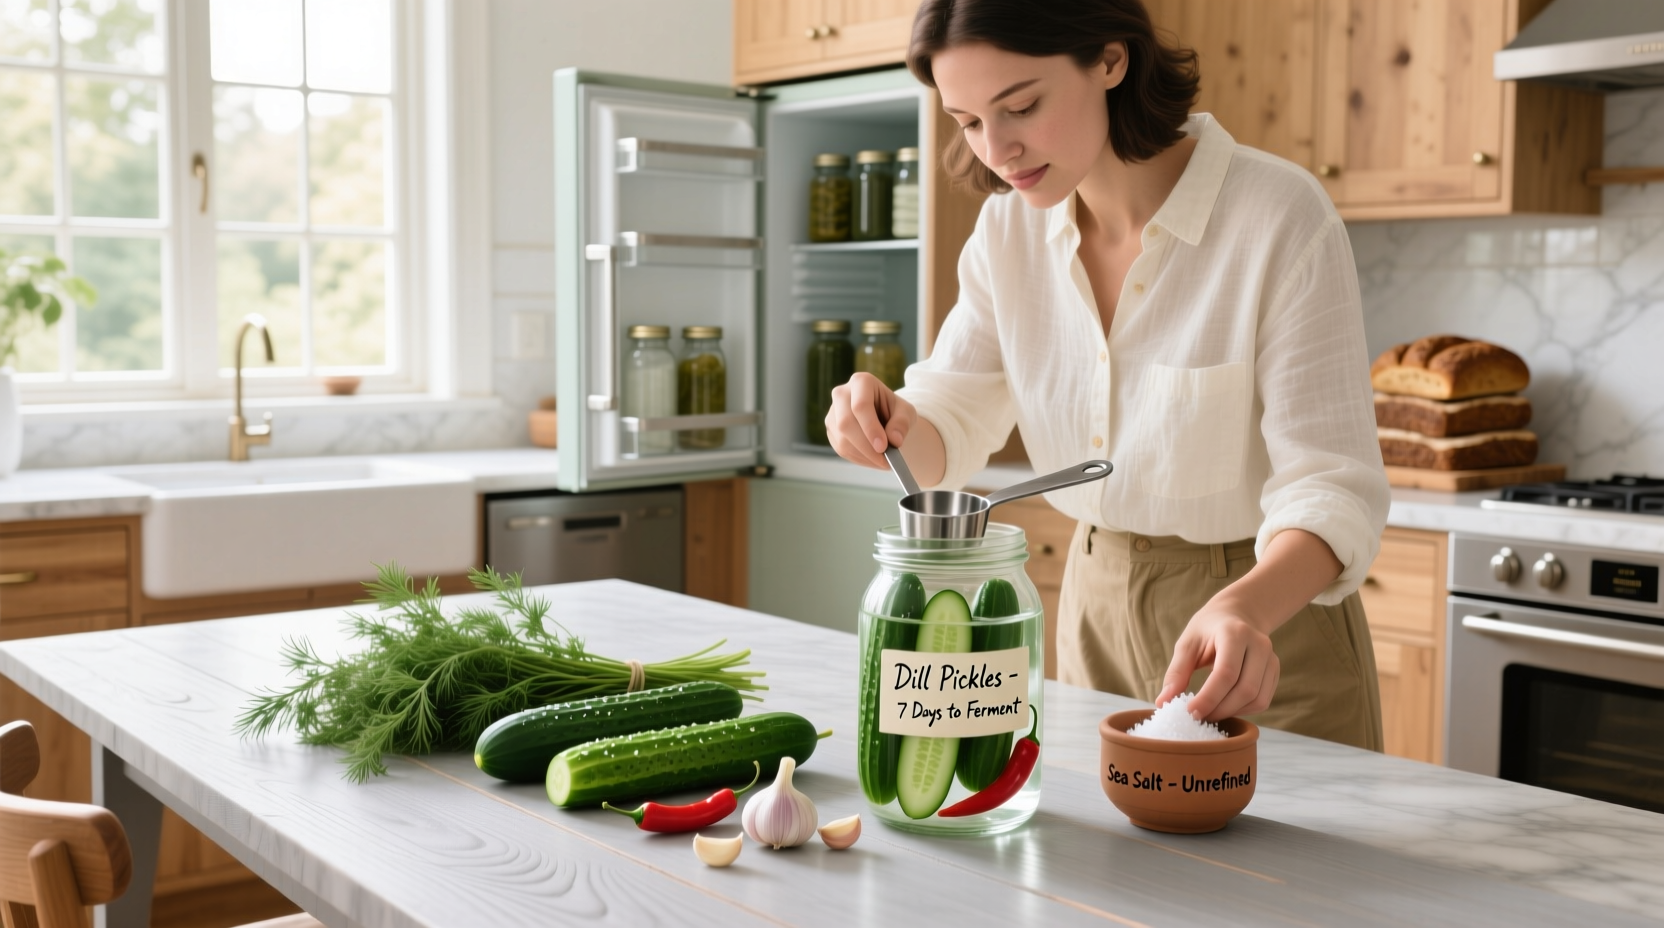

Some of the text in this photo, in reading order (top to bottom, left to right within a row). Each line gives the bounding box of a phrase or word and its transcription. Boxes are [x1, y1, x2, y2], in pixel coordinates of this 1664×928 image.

[894, 663, 932, 691] Dill
[939, 663, 1002, 692] Pickles
[897, 696, 1022, 728] 7 Days to Ferment
[1107, 763, 1129, 786] Sea
[1132, 770, 1163, 792] Salt
[1182, 765, 1251, 793] Unrefined
